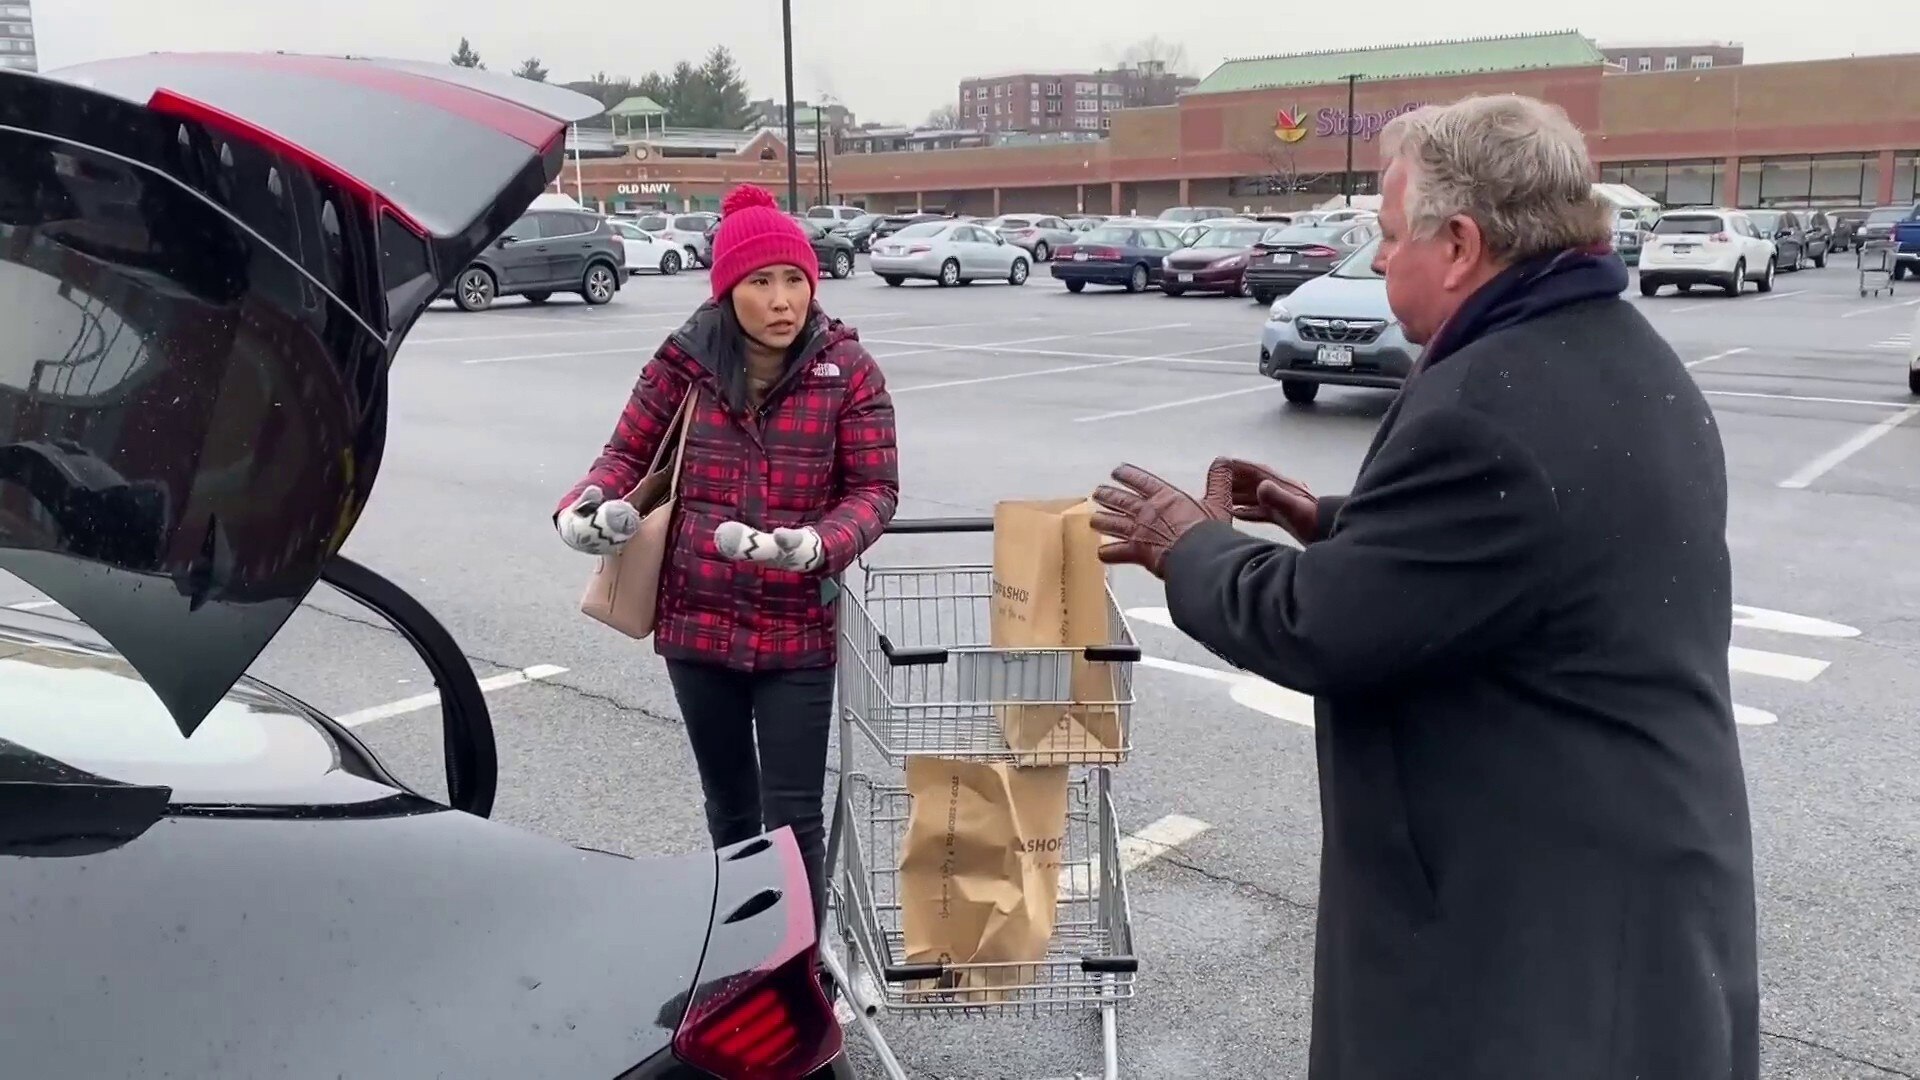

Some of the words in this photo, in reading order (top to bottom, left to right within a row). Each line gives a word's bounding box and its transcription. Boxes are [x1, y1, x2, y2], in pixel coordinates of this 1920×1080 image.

[617, 183, 640, 194] OLD
[640, 183, 670, 194] NAVY
[951, 775, 960, 798] STOP
